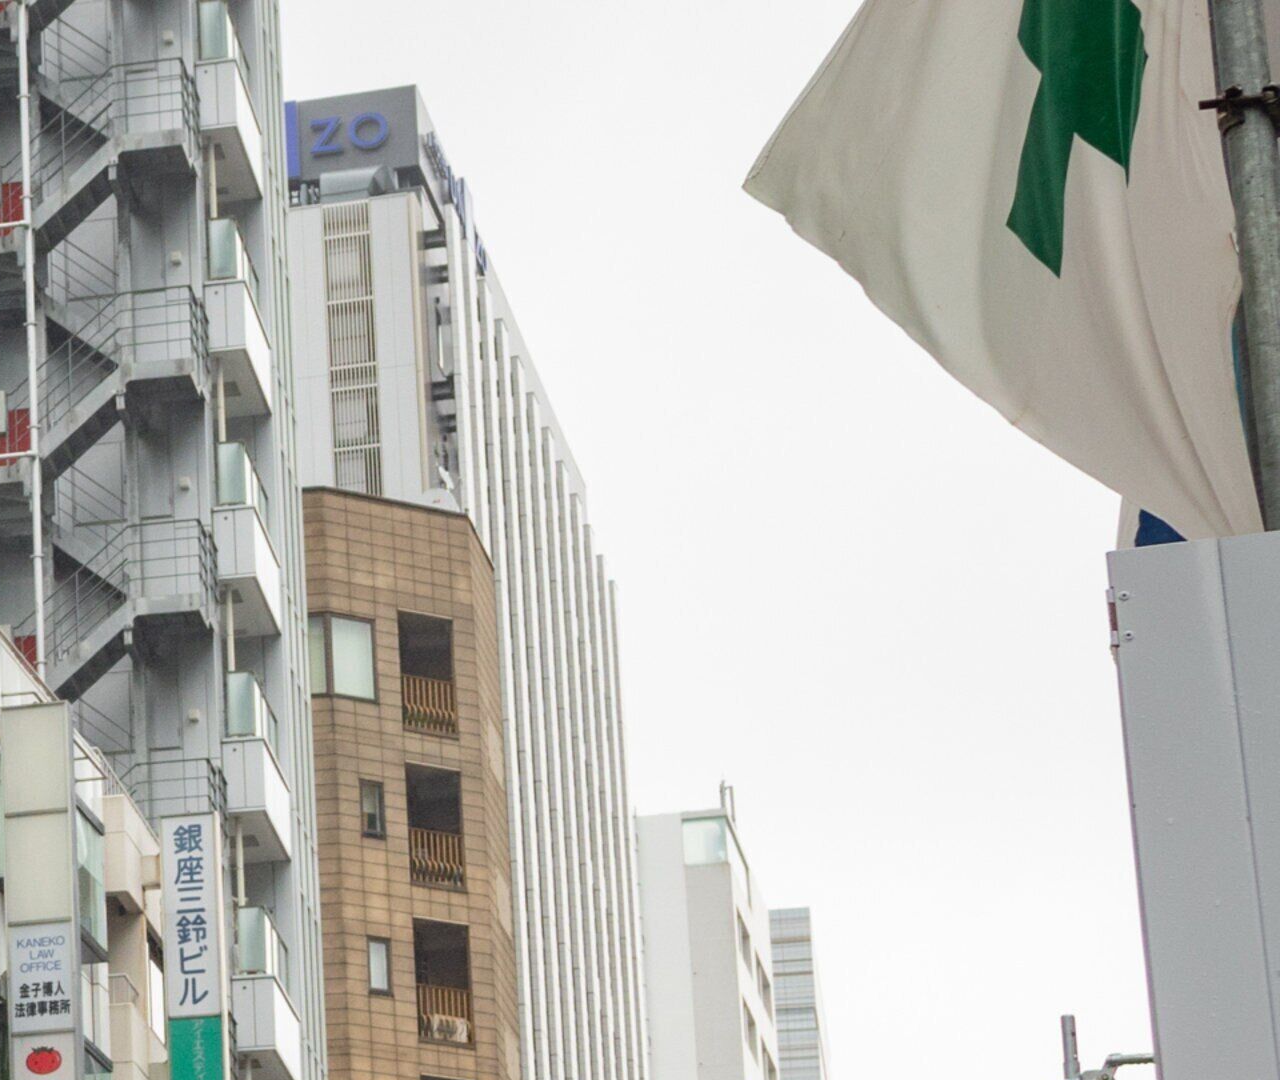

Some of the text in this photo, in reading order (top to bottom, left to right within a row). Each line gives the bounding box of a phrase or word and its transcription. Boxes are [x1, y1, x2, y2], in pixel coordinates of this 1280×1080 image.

[172, 823, 210, 1007] 銀座三鈴ビル
[16, 935, 66, 949] KANEKO
[29, 949, 55, 961] LAW
[20, 960, 63, 974] OFFICE
[14, 999, 72, 1019] 法律事務所
